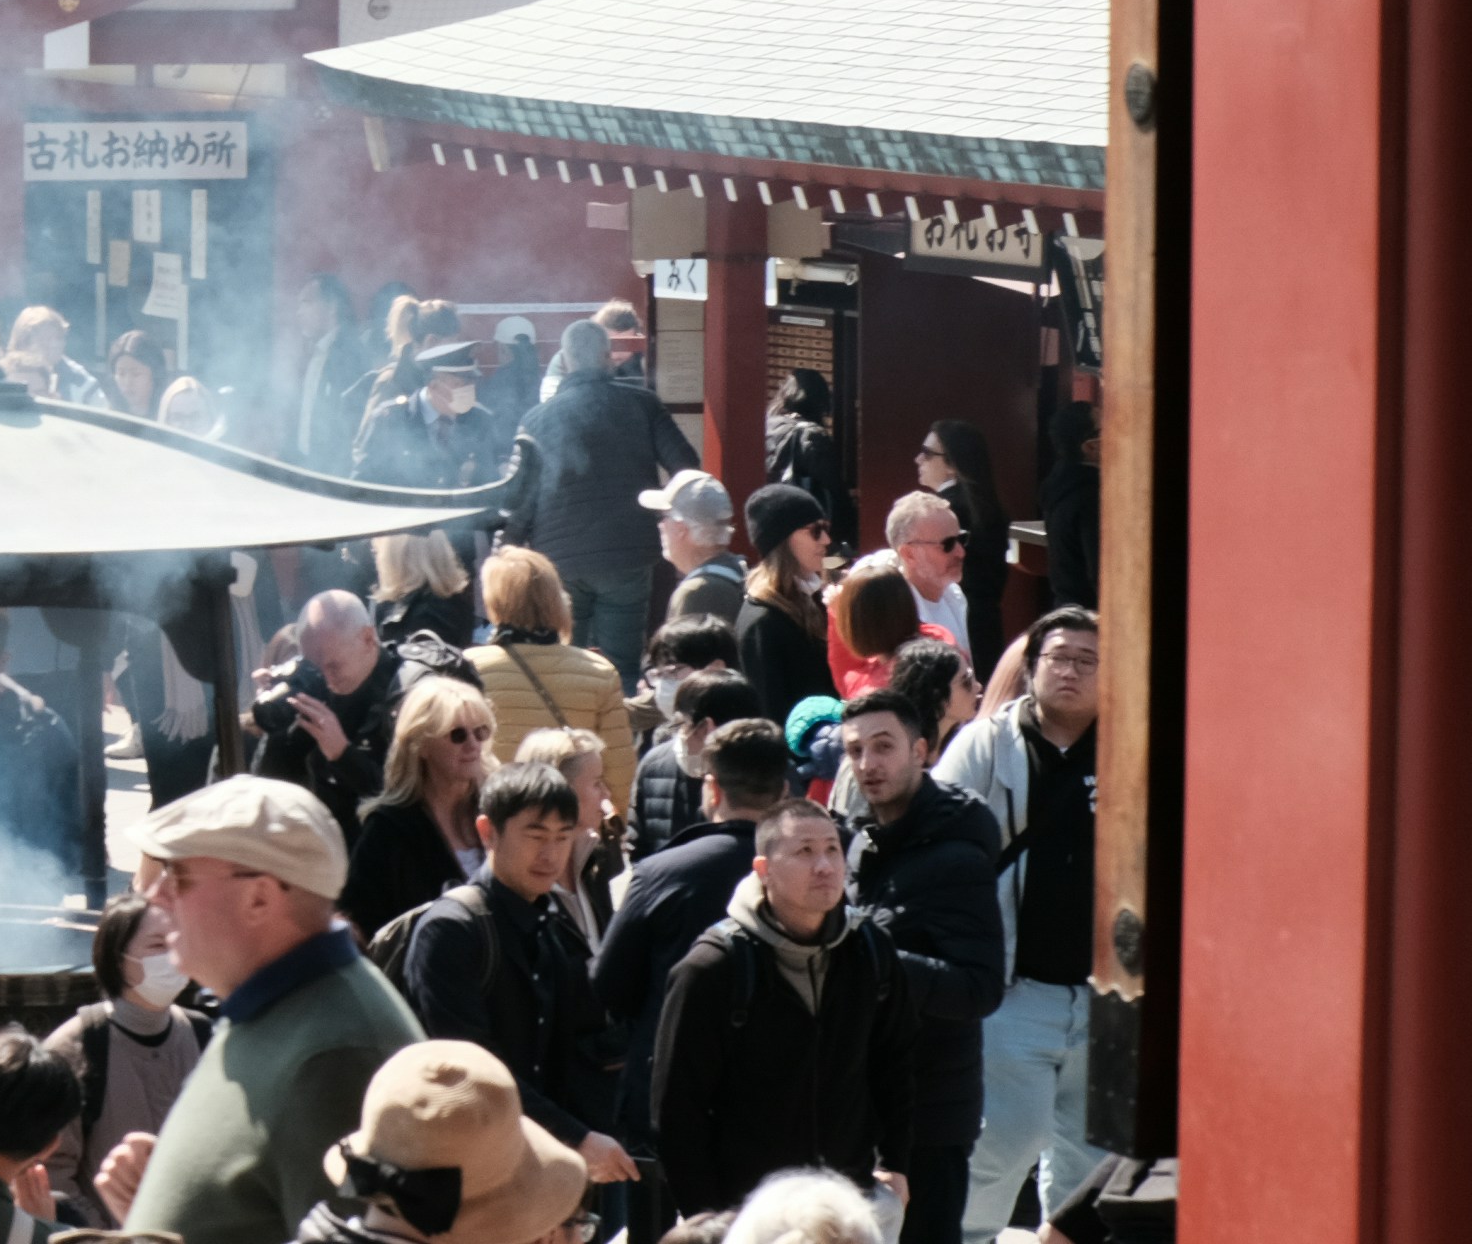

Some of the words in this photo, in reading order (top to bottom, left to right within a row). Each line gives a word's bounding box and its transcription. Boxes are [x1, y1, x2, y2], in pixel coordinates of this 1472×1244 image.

[25, 129, 238, 172] 古札お納め所
